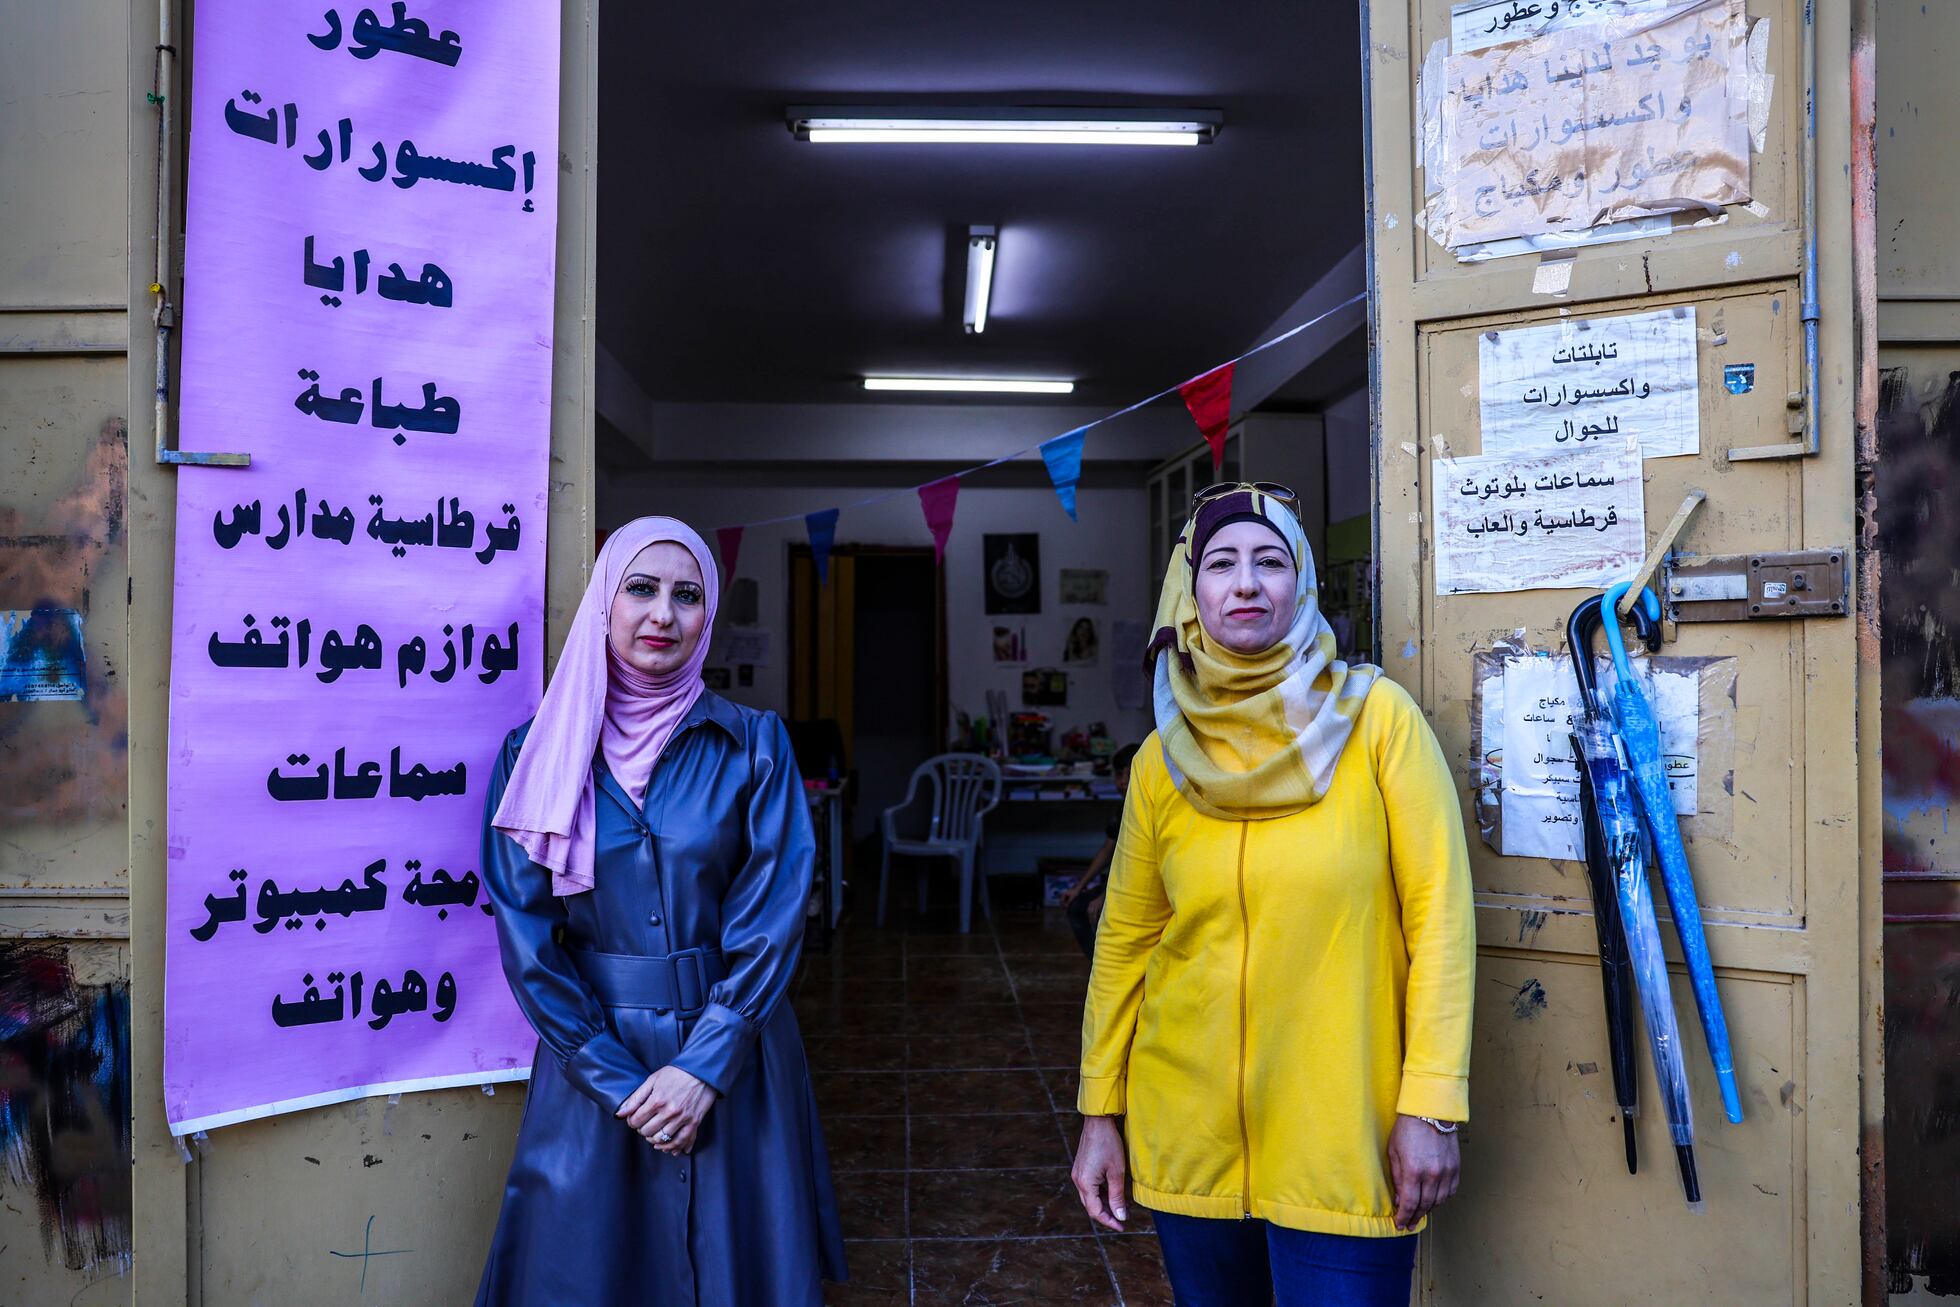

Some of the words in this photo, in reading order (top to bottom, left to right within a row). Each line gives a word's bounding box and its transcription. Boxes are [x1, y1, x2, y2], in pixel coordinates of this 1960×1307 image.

[307, 2, 462, 67] عطور
[304, 235, 452, 308] هدايا
[1553, 343, 1617, 365] تابلتات
[295, 368, 460, 446] طباعة
[1556, 416, 1618, 442] للجوال
[1460, 475, 1527, 500] بلوتوث
[1535, 472, 1614, 490] سماعات
[214, 488, 355, 550] مدارس
[367, 494, 520, 564] قرطاسية
[1466, 514, 1527, 538] والعاب
[1534, 505, 1617, 535] قرطاسية
[208, 614, 382, 683] هواتف
[398, 622, 519, 688] لوازم
[1523, 713, 1556, 723] ساعات
[1539, 697, 1565, 709] مكياج
[267, 746, 466, 801] سماعات
[1541, 814, 1579, 825] وتصوير
[190, 859, 387, 941] كمبيوتر
[272, 970, 456, 1030] وهواتف
